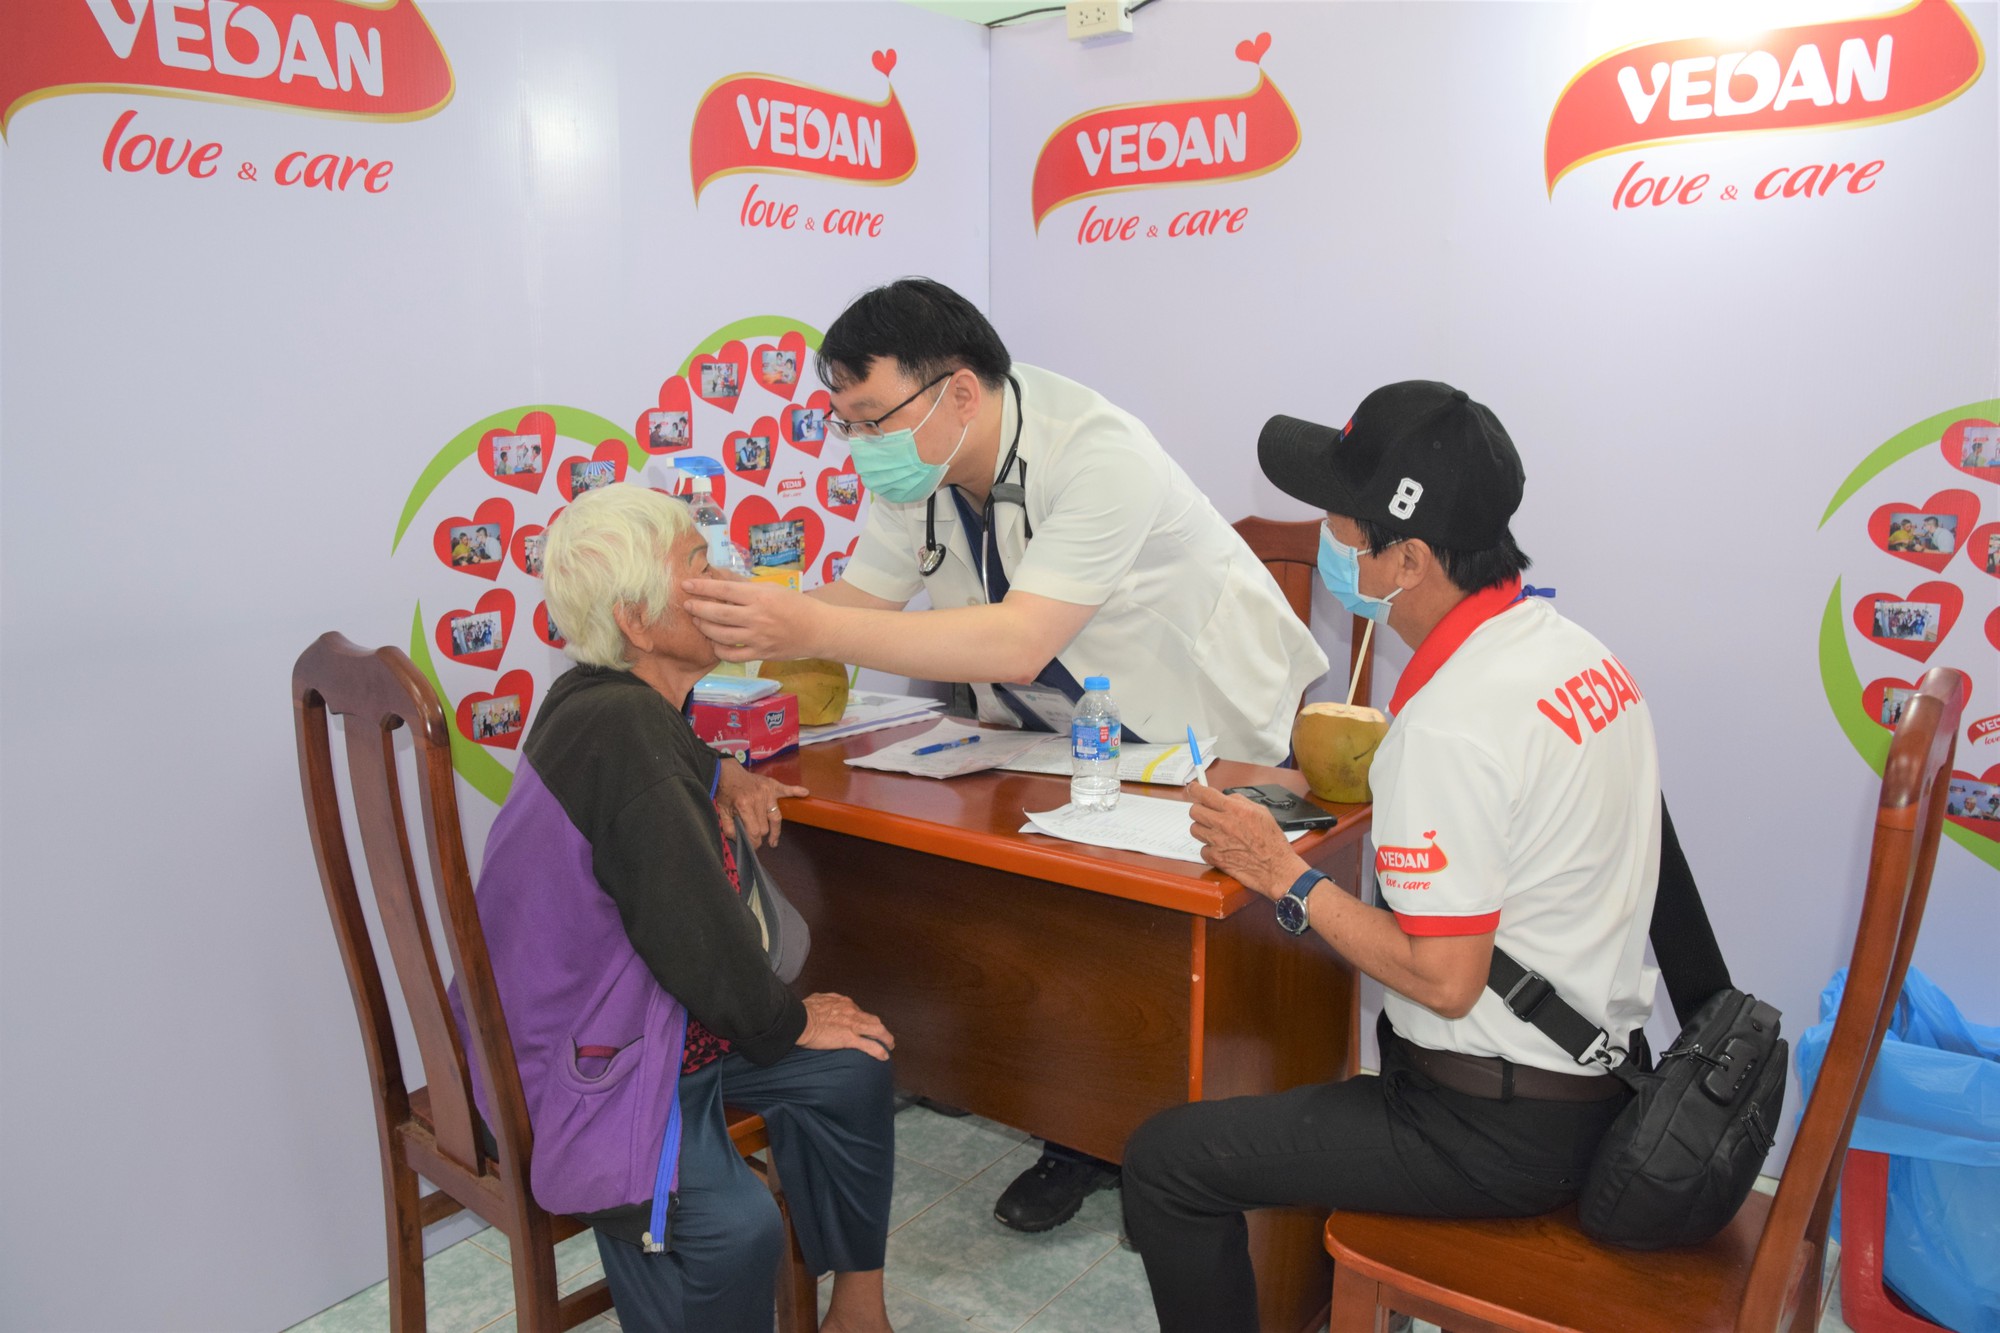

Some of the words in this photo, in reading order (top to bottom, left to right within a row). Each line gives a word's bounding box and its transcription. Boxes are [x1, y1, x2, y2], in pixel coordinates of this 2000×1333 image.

[86, 0, 385, 97] VEDAN
[1617, 34, 1893, 125] VEDAN
[102, 110, 223, 179] love
[237, 162, 257, 182] &
[273, 151, 394, 194] care
[737, 94, 882, 169] VEDAN
[1077, 111, 1247, 176] VEDAN
[740, 184, 798, 230] love
[804, 218, 815, 231] &
[823, 205, 884, 238] care
[1612, 161, 1710, 210] love
[1720, 185, 1738, 201] &
[1754, 160, 1885, 200] care
[1077, 205, 1140, 245] love
[1147, 225, 1158, 238] &
[1168, 205, 1248, 238] care
[1388, 477, 1423, 520] 8
[1380, 851, 1430, 869] VEDAN
[1402, 881, 1431, 891] care
